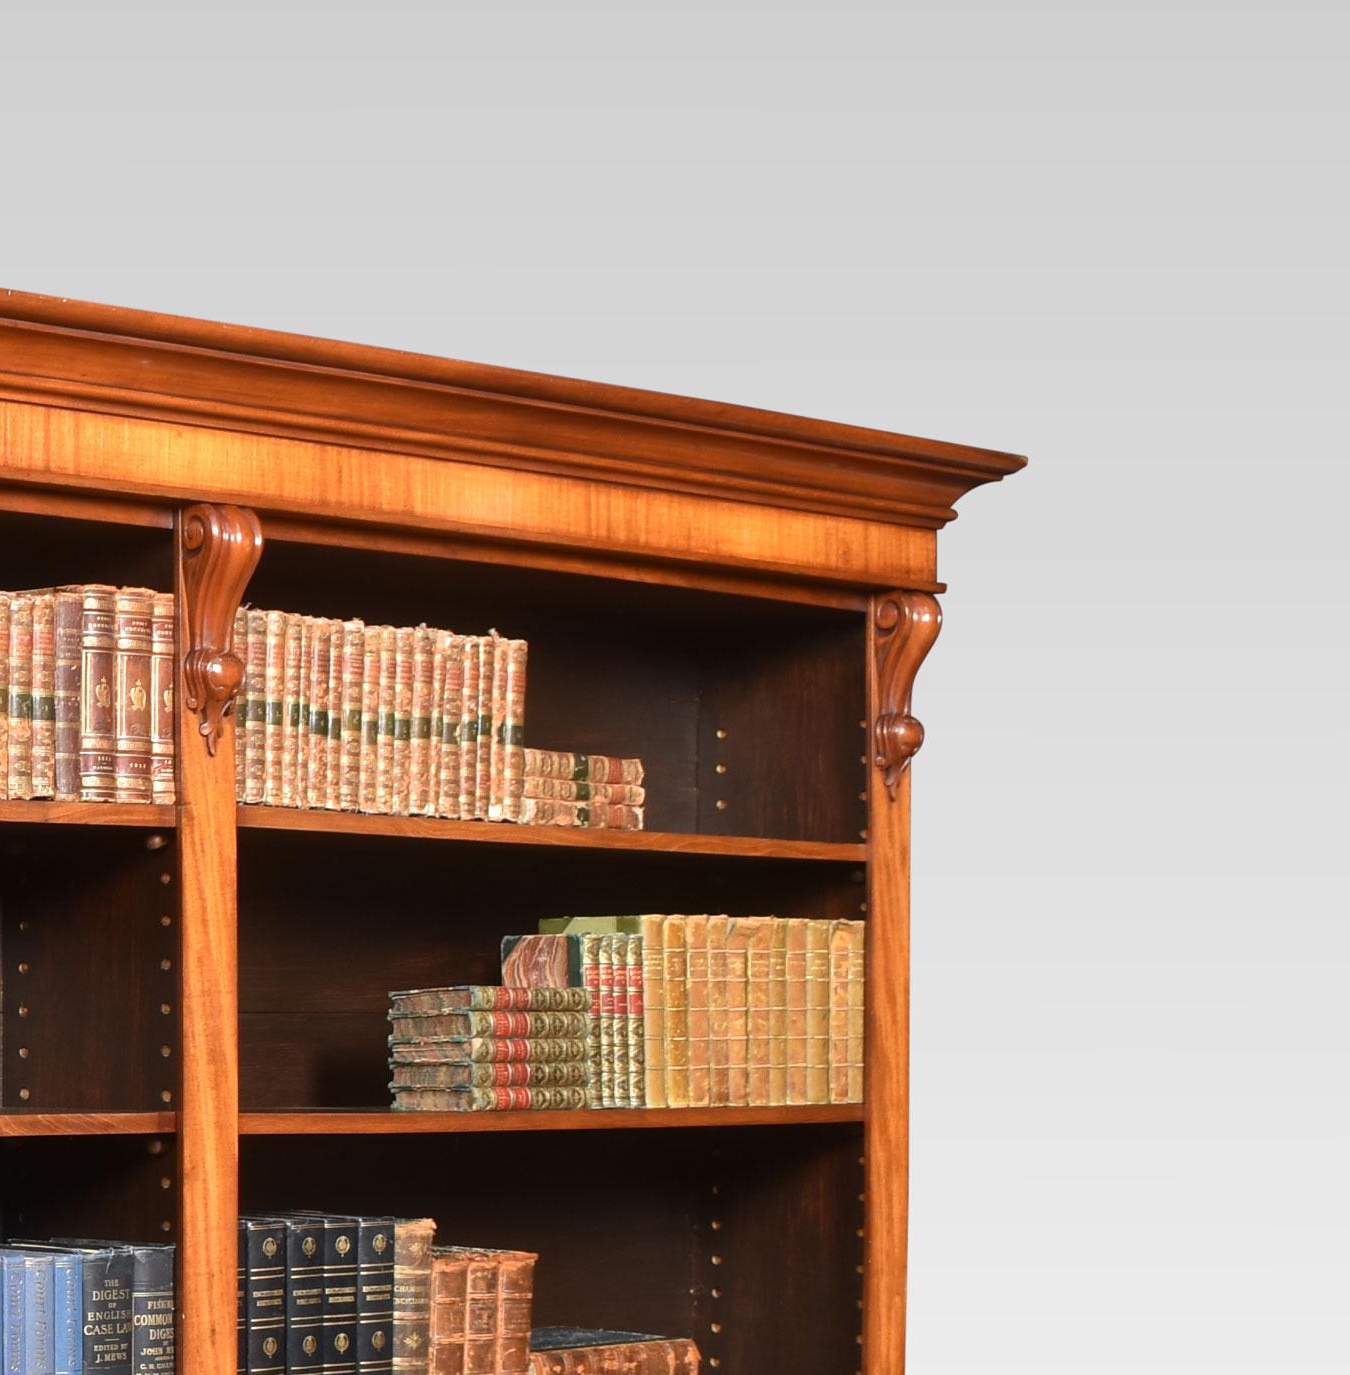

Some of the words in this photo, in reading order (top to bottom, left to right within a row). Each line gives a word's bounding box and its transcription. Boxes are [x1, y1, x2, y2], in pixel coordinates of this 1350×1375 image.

[35, 1265, 48, 1314] Court
[92, 1289, 130, 1301] DIGEST
[84, 1325, 114, 1335] CASE
[35, 1321, 48, 1369] Forms
[104, 1353, 127, 1361] MEWS
